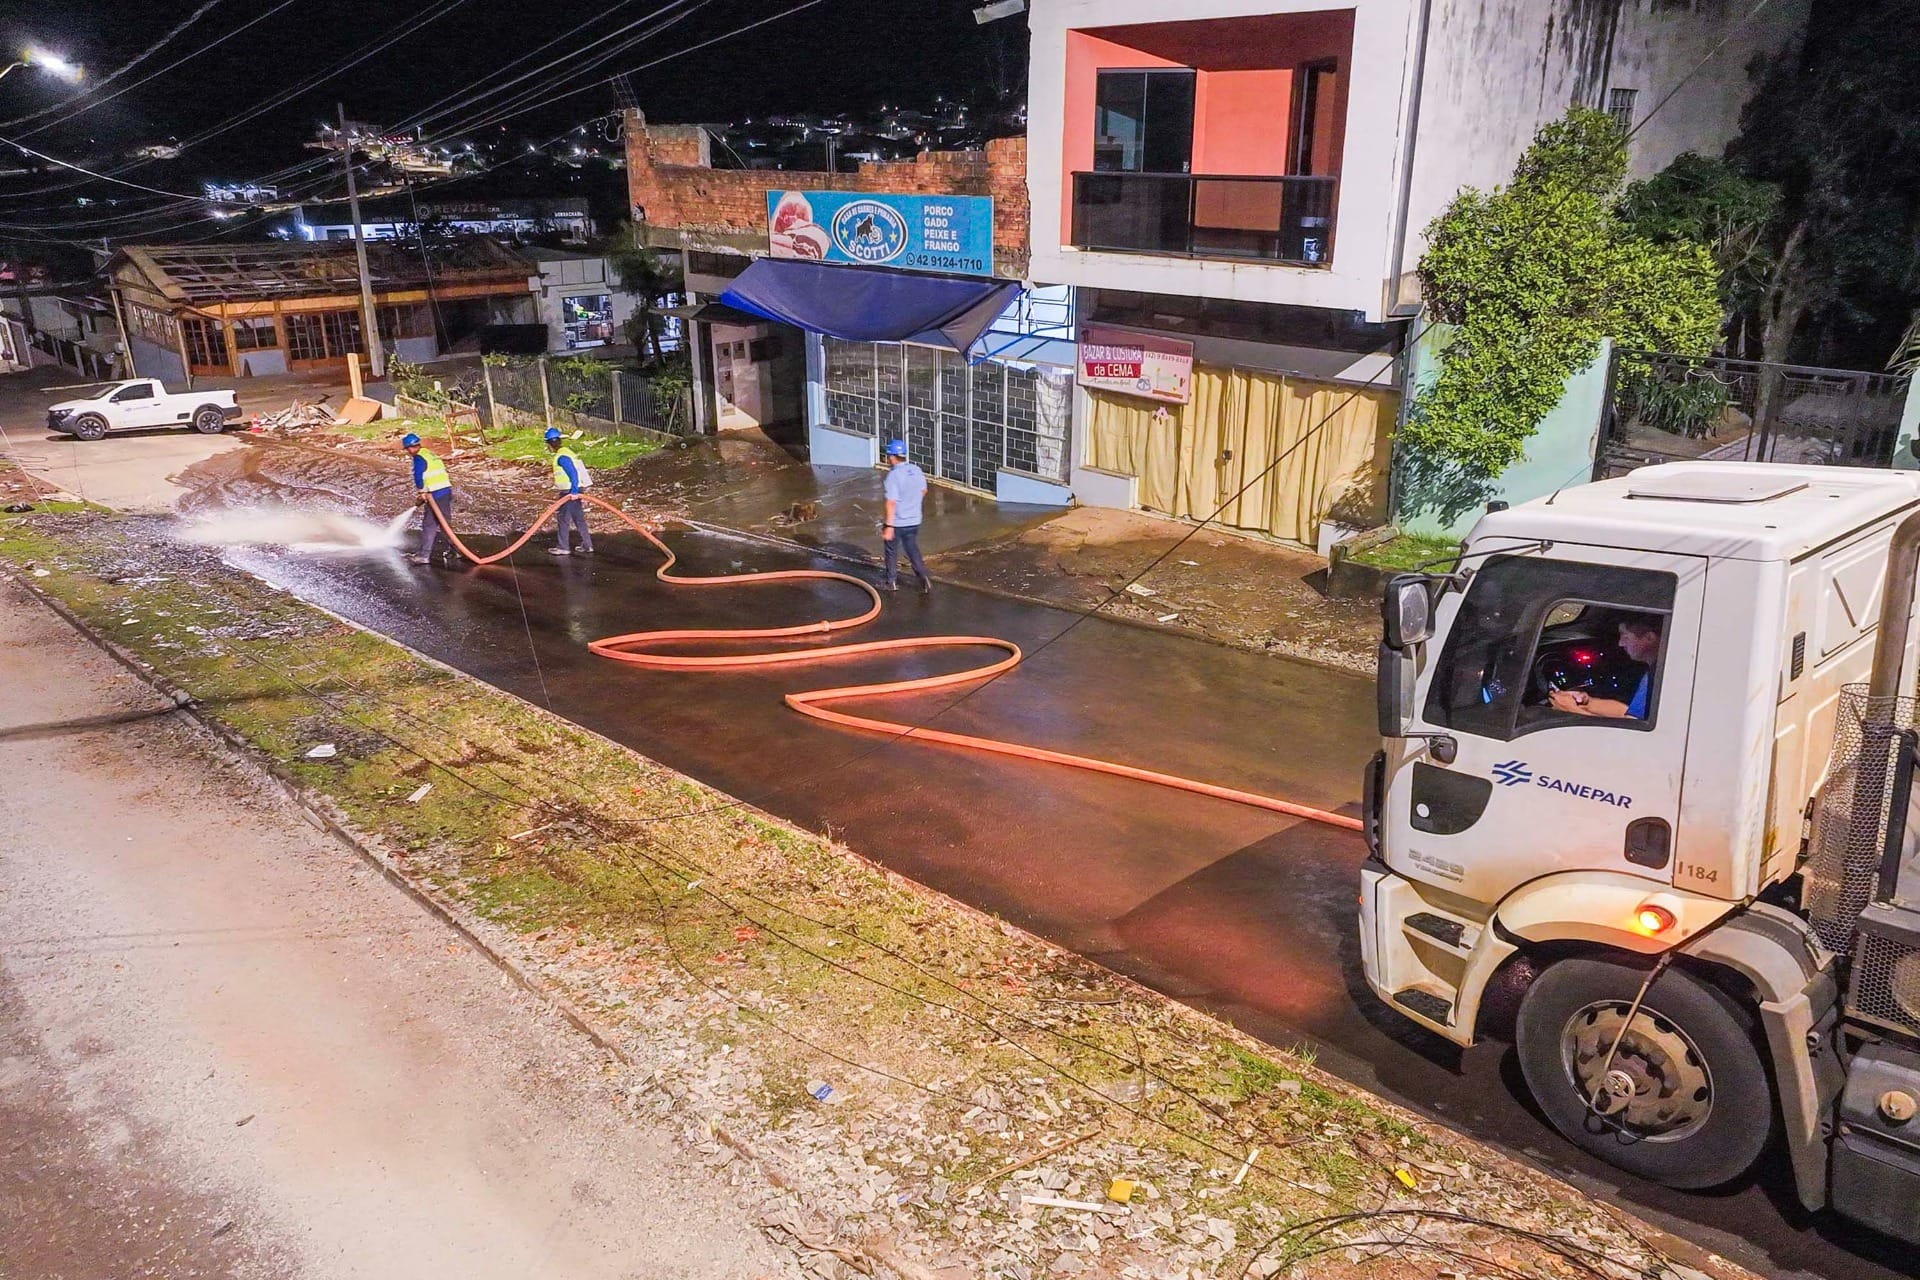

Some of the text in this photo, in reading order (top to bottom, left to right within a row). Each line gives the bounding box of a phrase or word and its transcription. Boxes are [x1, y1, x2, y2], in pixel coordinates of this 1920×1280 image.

[923, 205, 954, 217] PORCO
[923, 217, 949, 228] GADO
[924, 228, 957, 240] PEIXE E
[848, 240, 890, 259] SCOTTI
[924, 240, 960, 252] FRANGO
[916, 254, 983, 271] 42 9124-1710
[1083, 344, 1105, 360] BAZAR
[1094, 363, 1134, 377] da CEMA
[1537, 776, 1632, 809] SANEPAR
